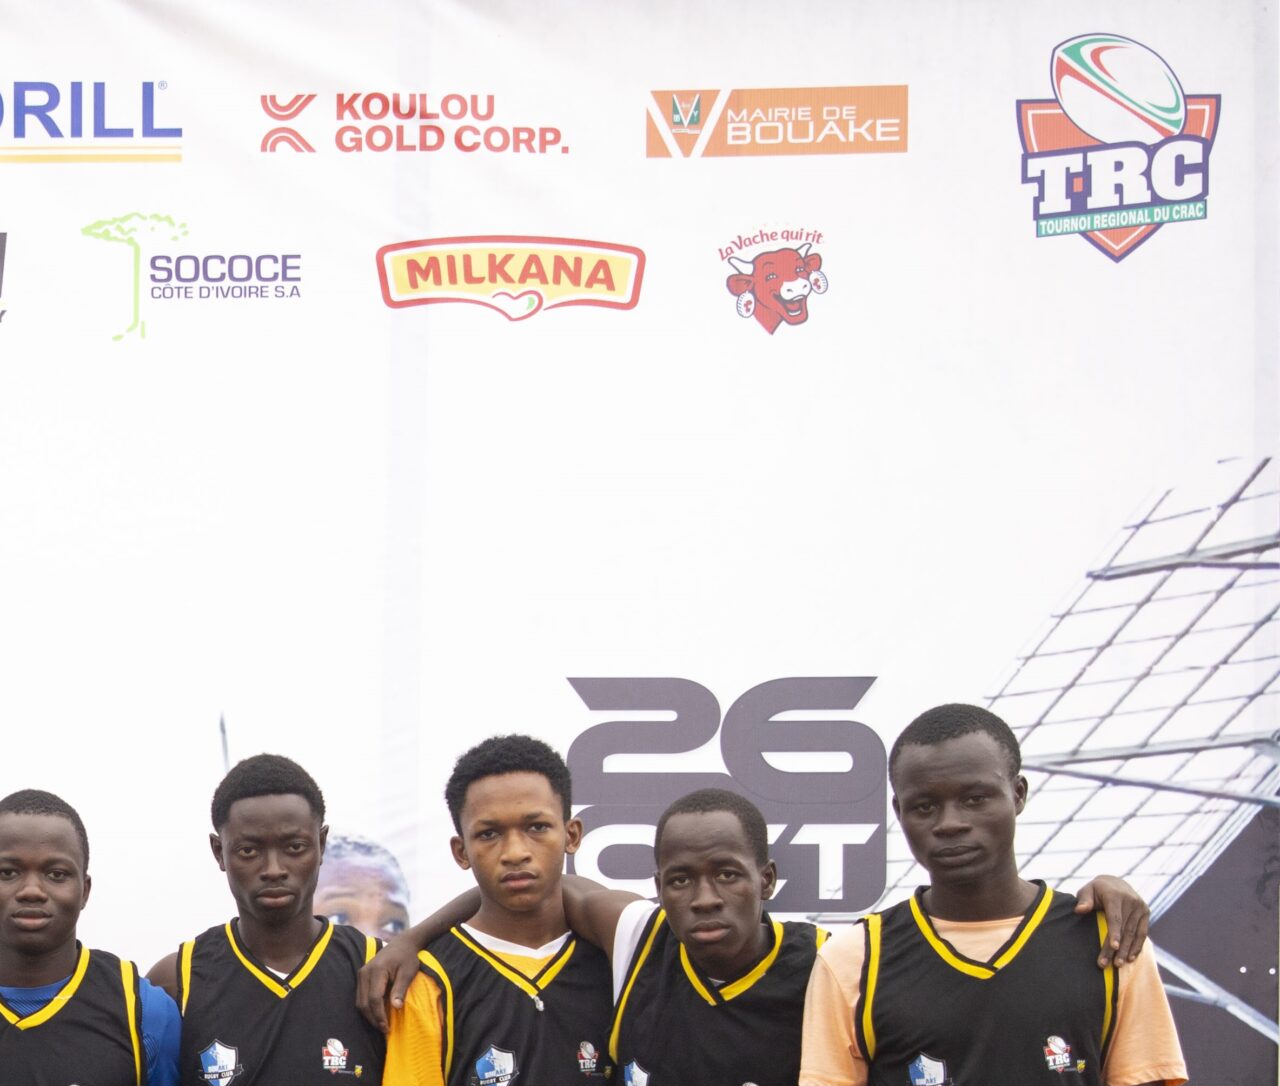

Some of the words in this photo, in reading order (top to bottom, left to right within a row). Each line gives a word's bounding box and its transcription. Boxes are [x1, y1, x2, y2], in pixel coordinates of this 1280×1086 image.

[336, 92, 495, 122] KOULOU
[727, 107, 812, 122] MAIRIE
[822, 105, 857, 120] DE
[334, 126, 445, 154] GOLD
[453, 126, 570, 155] CORP.
[727, 118, 901, 145] BOUAKE
[1027, 139, 1204, 215] TRC
[1040, 217, 1091, 235] TOURNOI
[1093, 209, 1151, 229] REGIONAL
[1153, 206, 1170, 221] DU
[1172, 203, 1205, 220] CRAC
[718, 246, 734, 261] La
[730, 229, 779, 251] Vache
[781, 228, 804, 242] qui
[805, 230, 824, 244] rit
[149, 253, 302, 284] SOCOCE
[406, 252, 617, 292] MILKANA
[150, 282, 195, 300] CÔTE
[198, 285, 270, 299] D'IVOIRE
[274, 285, 301, 299] S.A
[567, 676, 887, 805] 26
[571, 824, 880, 901] OT
